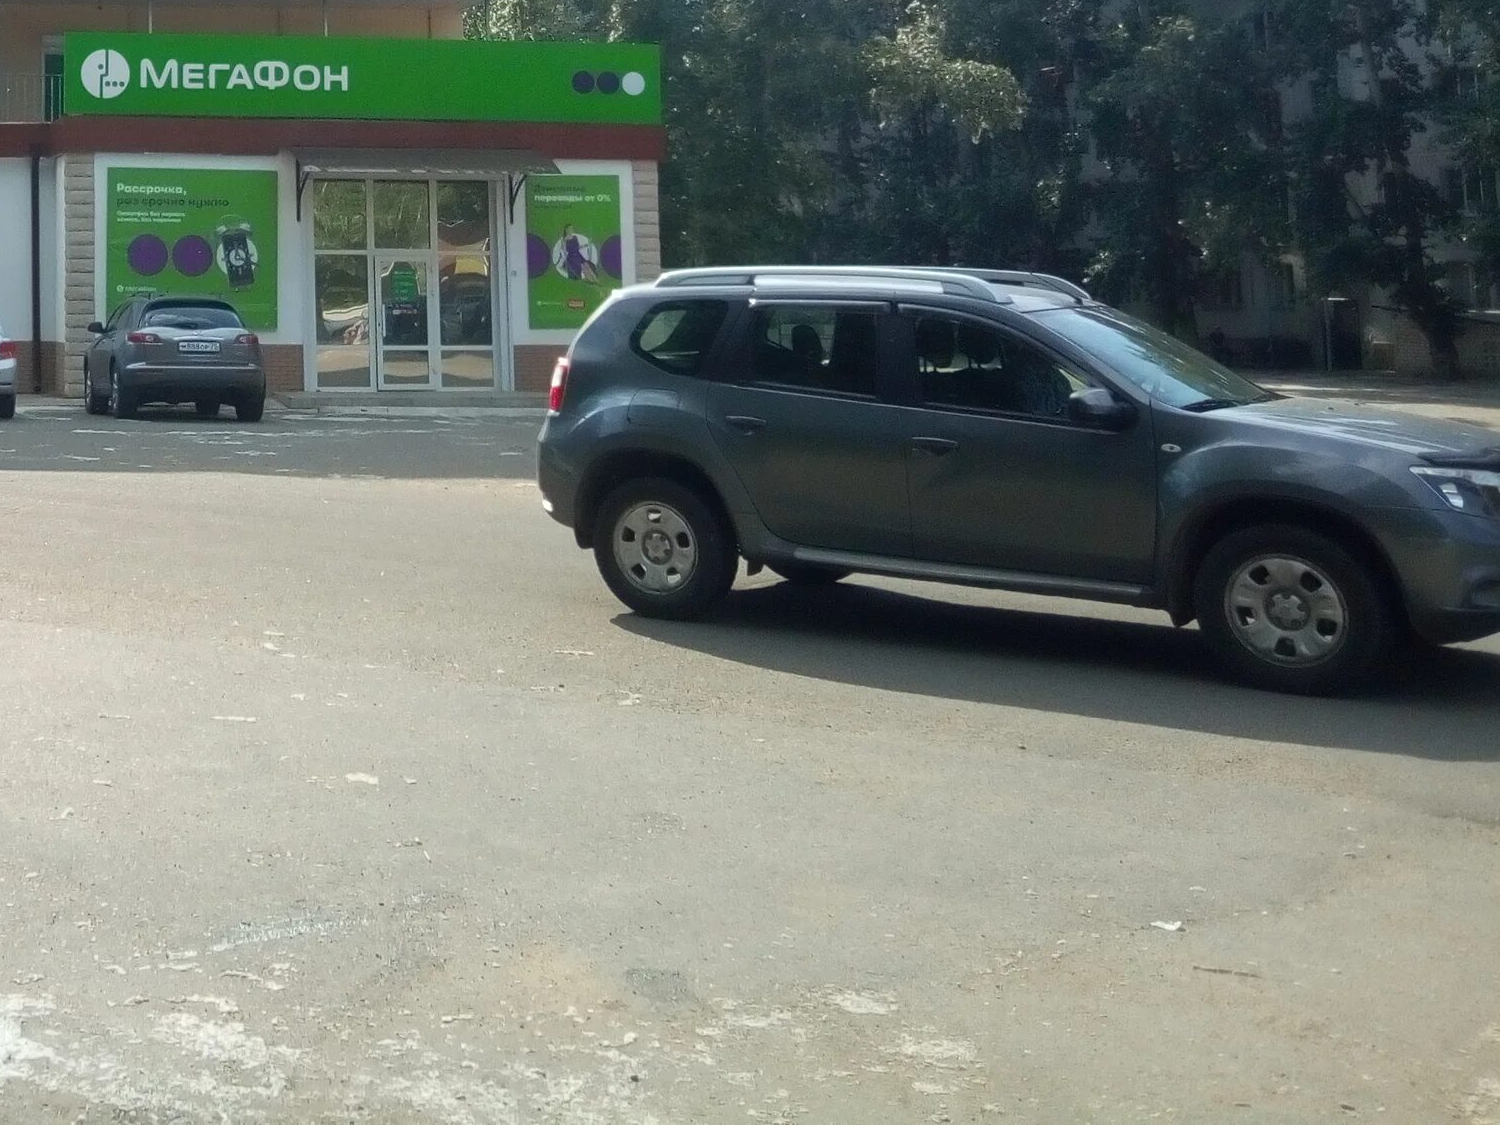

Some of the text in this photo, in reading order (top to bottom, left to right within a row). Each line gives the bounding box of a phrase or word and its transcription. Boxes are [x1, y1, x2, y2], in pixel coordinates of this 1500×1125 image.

[116, 183, 187, 196] Рассрочка,
[188, 198, 230, 209] нужно
[584, 195, 595, 203] от
[596, 194, 612, 203] 0%
